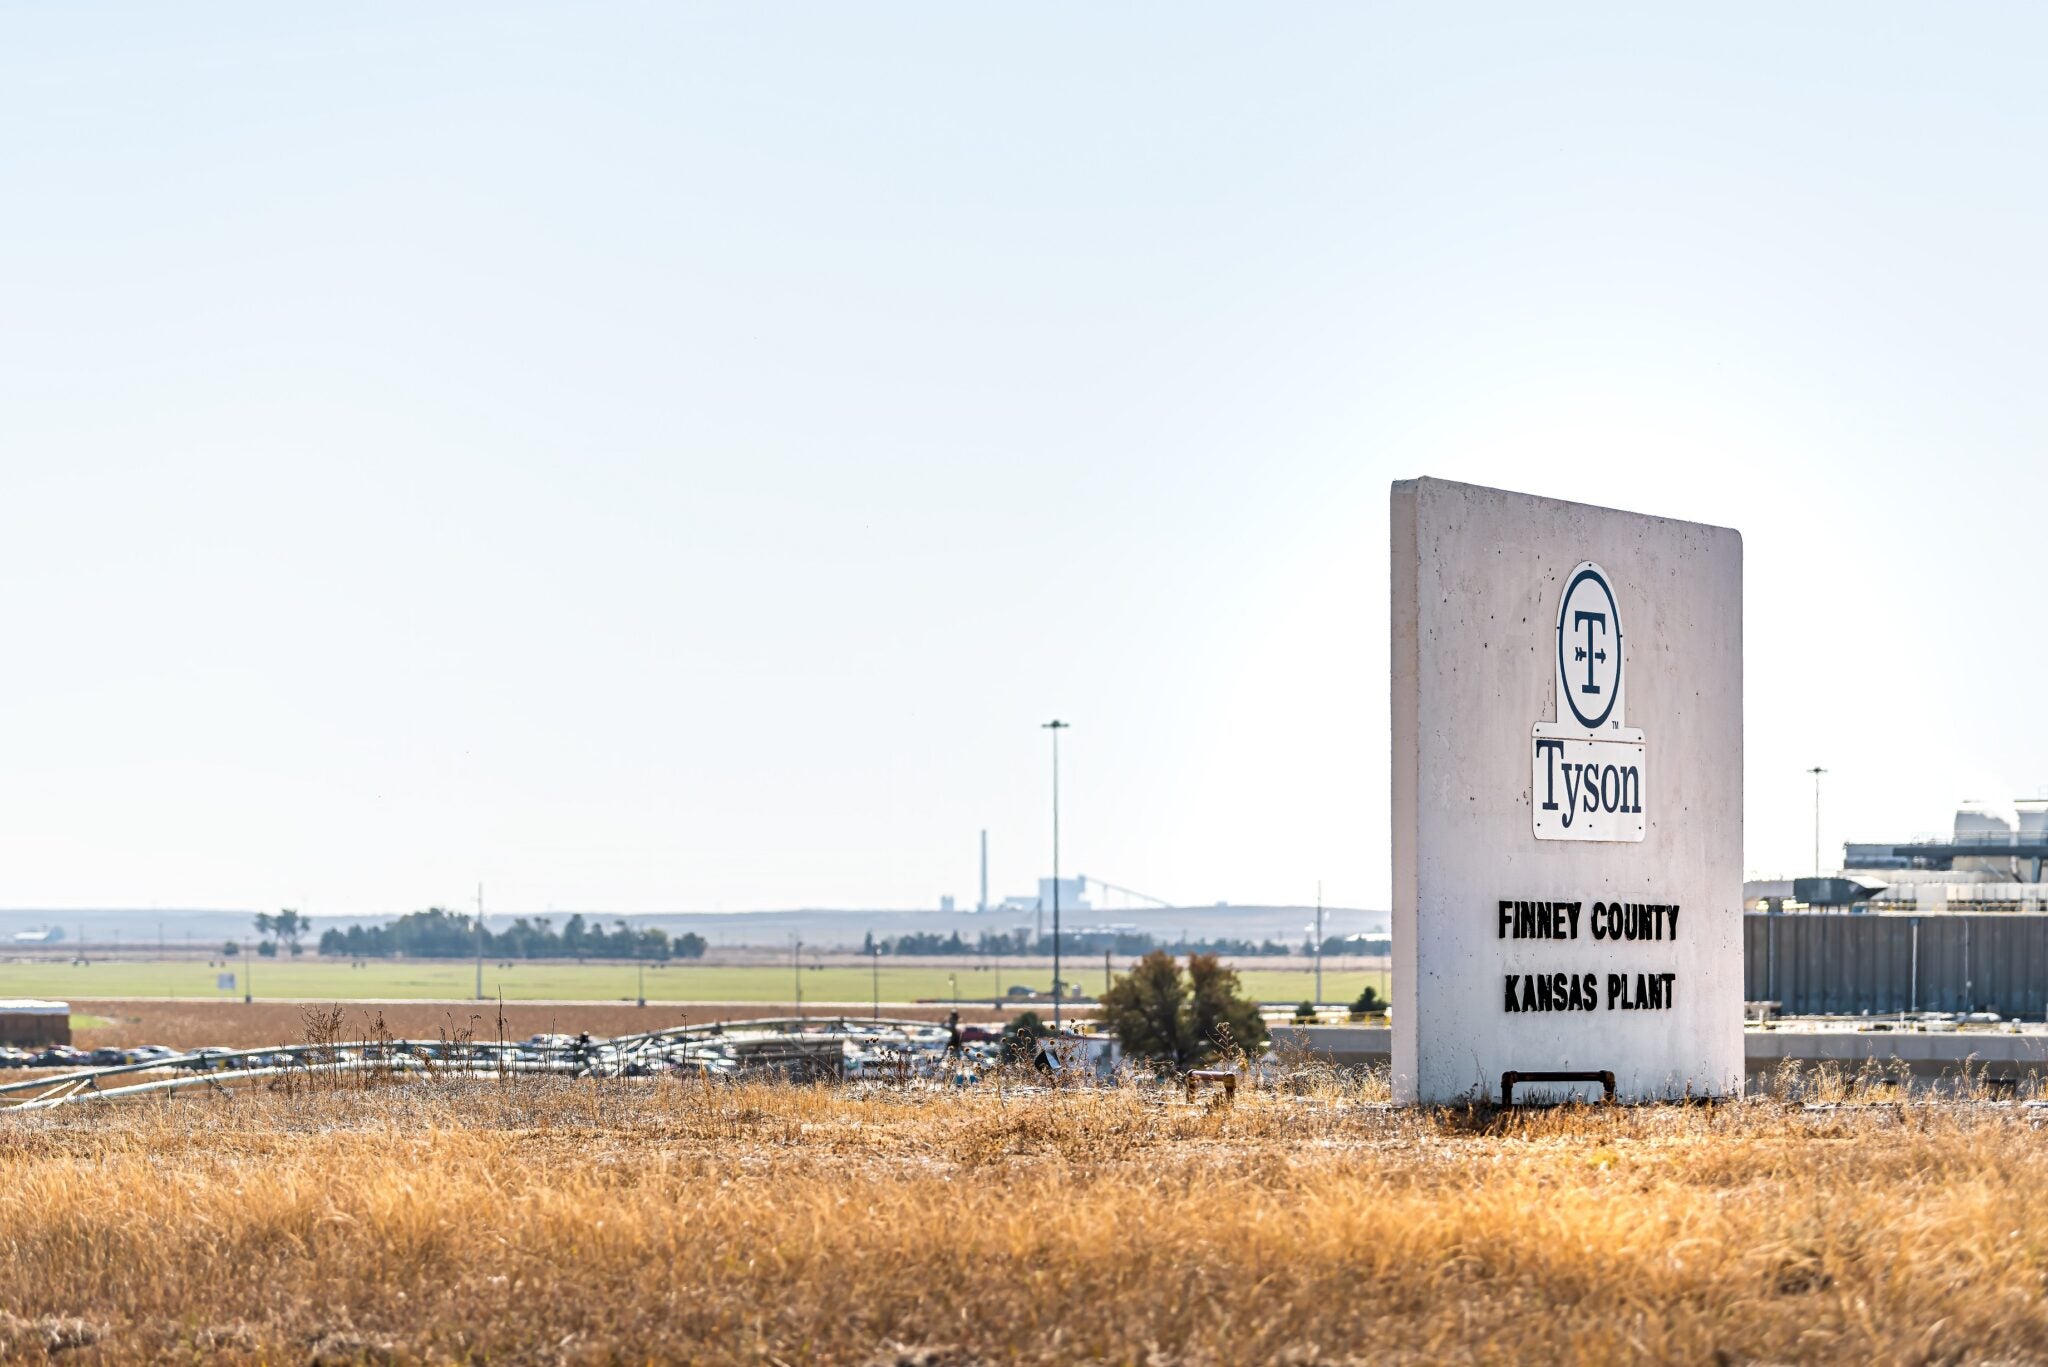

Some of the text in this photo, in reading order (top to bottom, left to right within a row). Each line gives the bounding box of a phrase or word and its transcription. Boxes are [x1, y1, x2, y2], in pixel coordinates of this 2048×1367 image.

[1574, 610, 1606, 694] T
[1612, 720, 1619, 729] TM
[1536, 740, 1642, 829] Tyson
[1499, 901, 1680, 940] FINNEY COUNTY
[1505, 973, 1676, 1012] KANSAS PLANT
